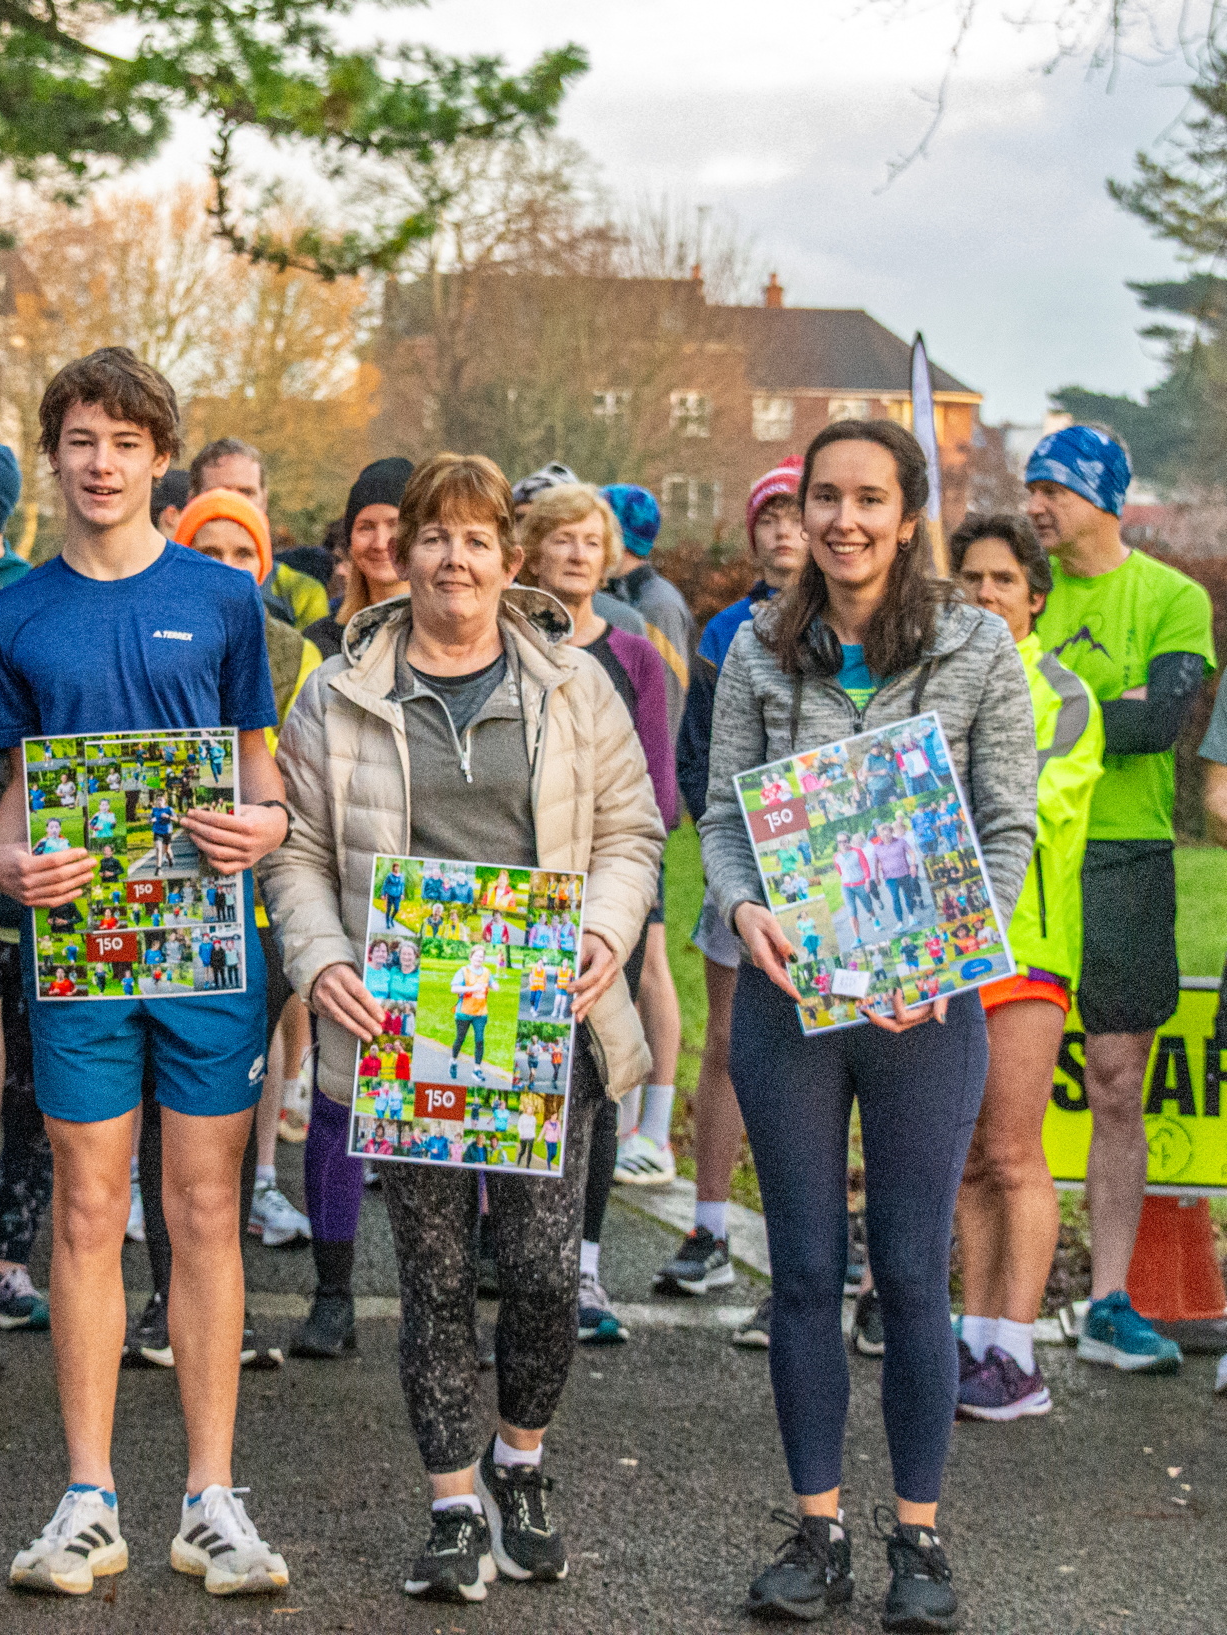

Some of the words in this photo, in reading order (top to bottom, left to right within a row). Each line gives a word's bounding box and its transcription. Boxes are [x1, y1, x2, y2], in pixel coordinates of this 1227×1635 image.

[763, 808, 793, 833] 150
[134, 883, 153, 898] 150
[96, 937, 123, 955] 150
[425, 1089, 455, 1112] 150
